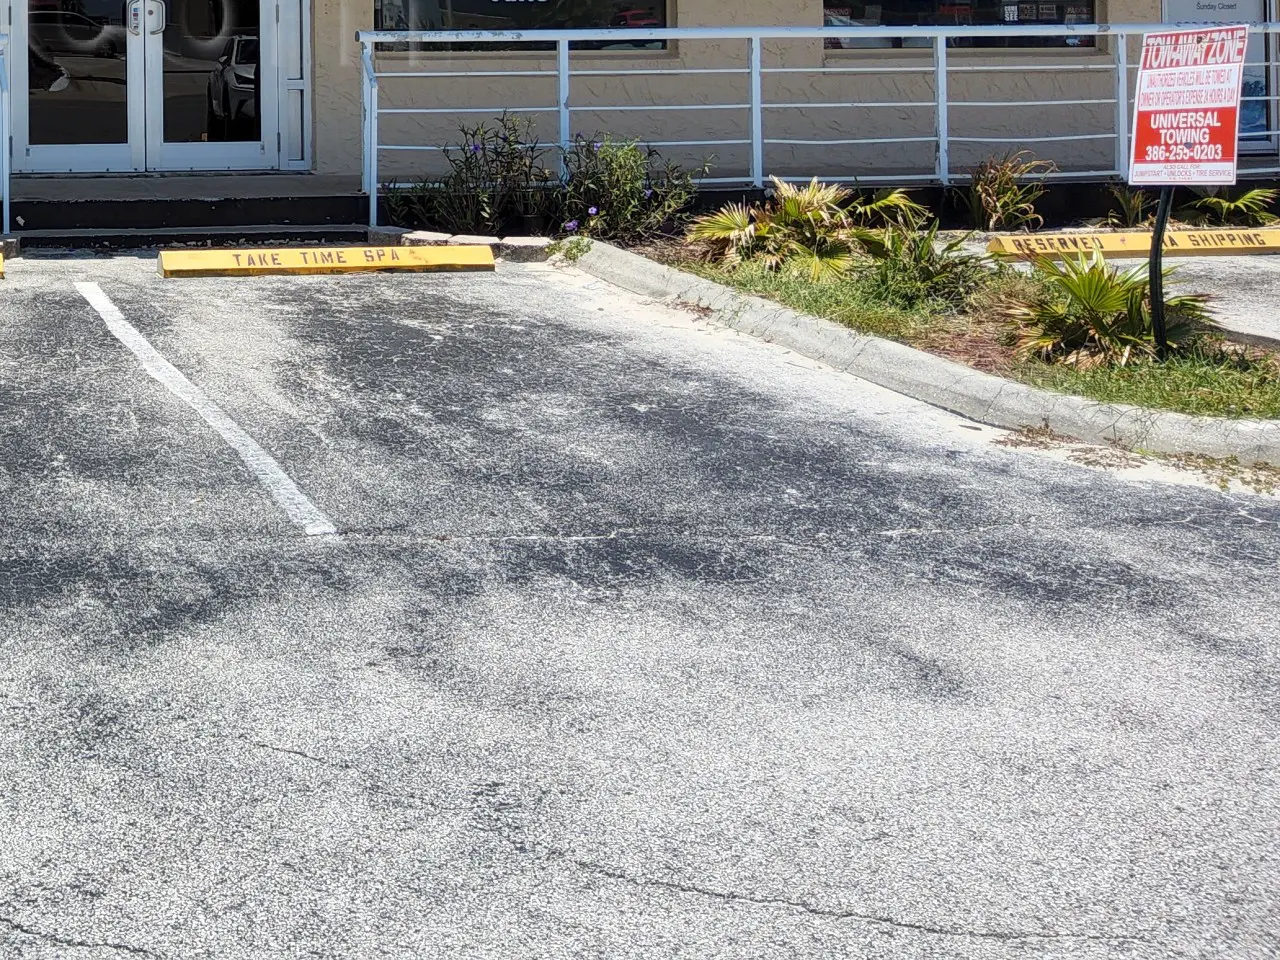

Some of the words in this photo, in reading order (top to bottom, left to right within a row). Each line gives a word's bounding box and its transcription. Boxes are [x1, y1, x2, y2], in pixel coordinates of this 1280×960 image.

[1196, 1, 1217, 10] Sunday
[1217, 2, 1237, 10] Closed
[1146, 34, 1210, 69] TOW-AWAY
[1207, 30, 1245, 63] ZONE
[1150, 111, 1222, 129] UNIVERSAL
[1159, 128, 1210, 144] TOWING
[1145, 144, 1222, 161] 386-255-0203
[1011, 235, 1105, 252] RESERVED
[1187, 232, 1267, 248] SHIPPING
[231, 252, 283, 267] TAKE
[299, 250, 348, 265] TIME
[363, 247, 401, 262] SPA
